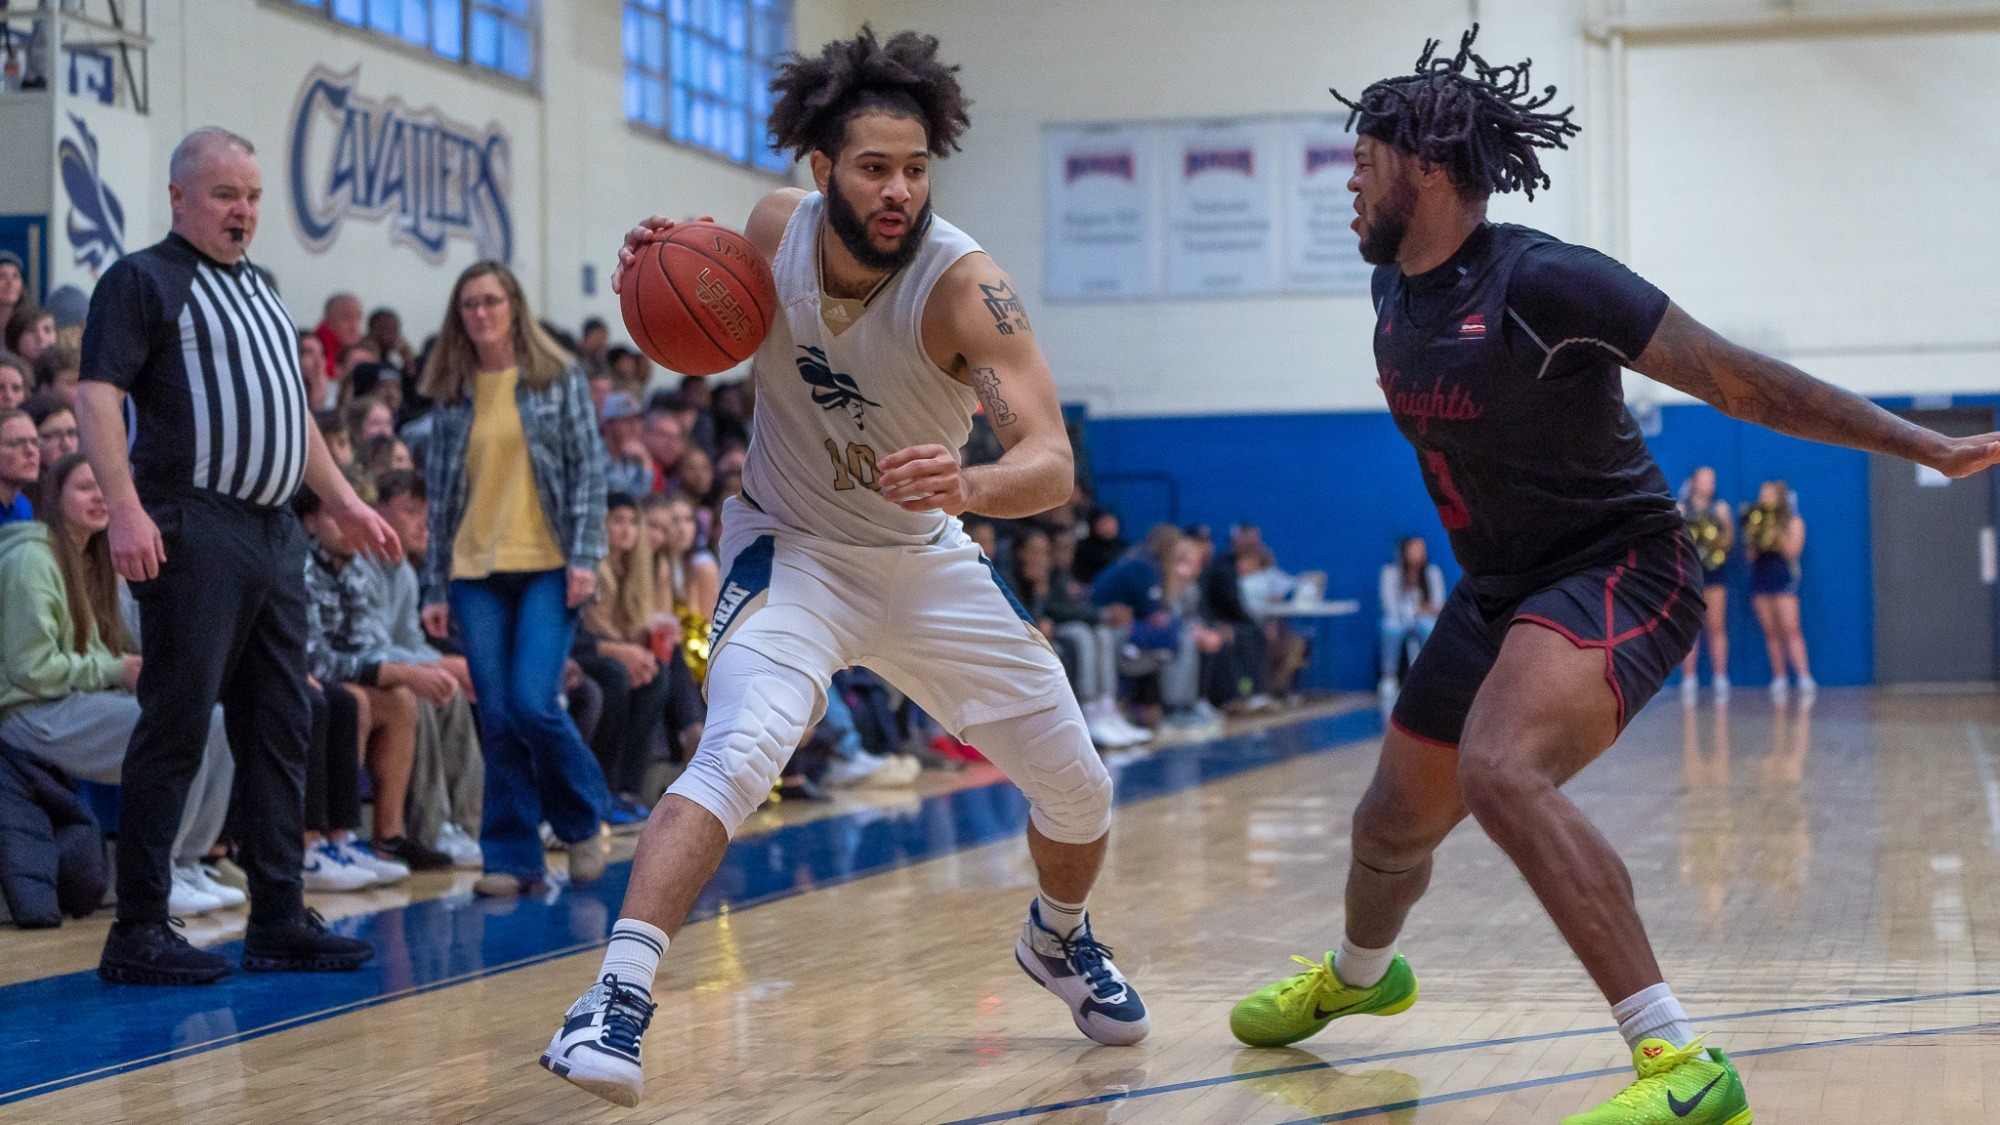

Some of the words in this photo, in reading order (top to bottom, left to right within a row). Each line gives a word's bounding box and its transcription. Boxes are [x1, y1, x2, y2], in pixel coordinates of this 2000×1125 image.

[288, 66, 512, 266] CAVALIERS
[697, 268, 757, 337] LEGACY
[824, 438, 883, 491] 10
